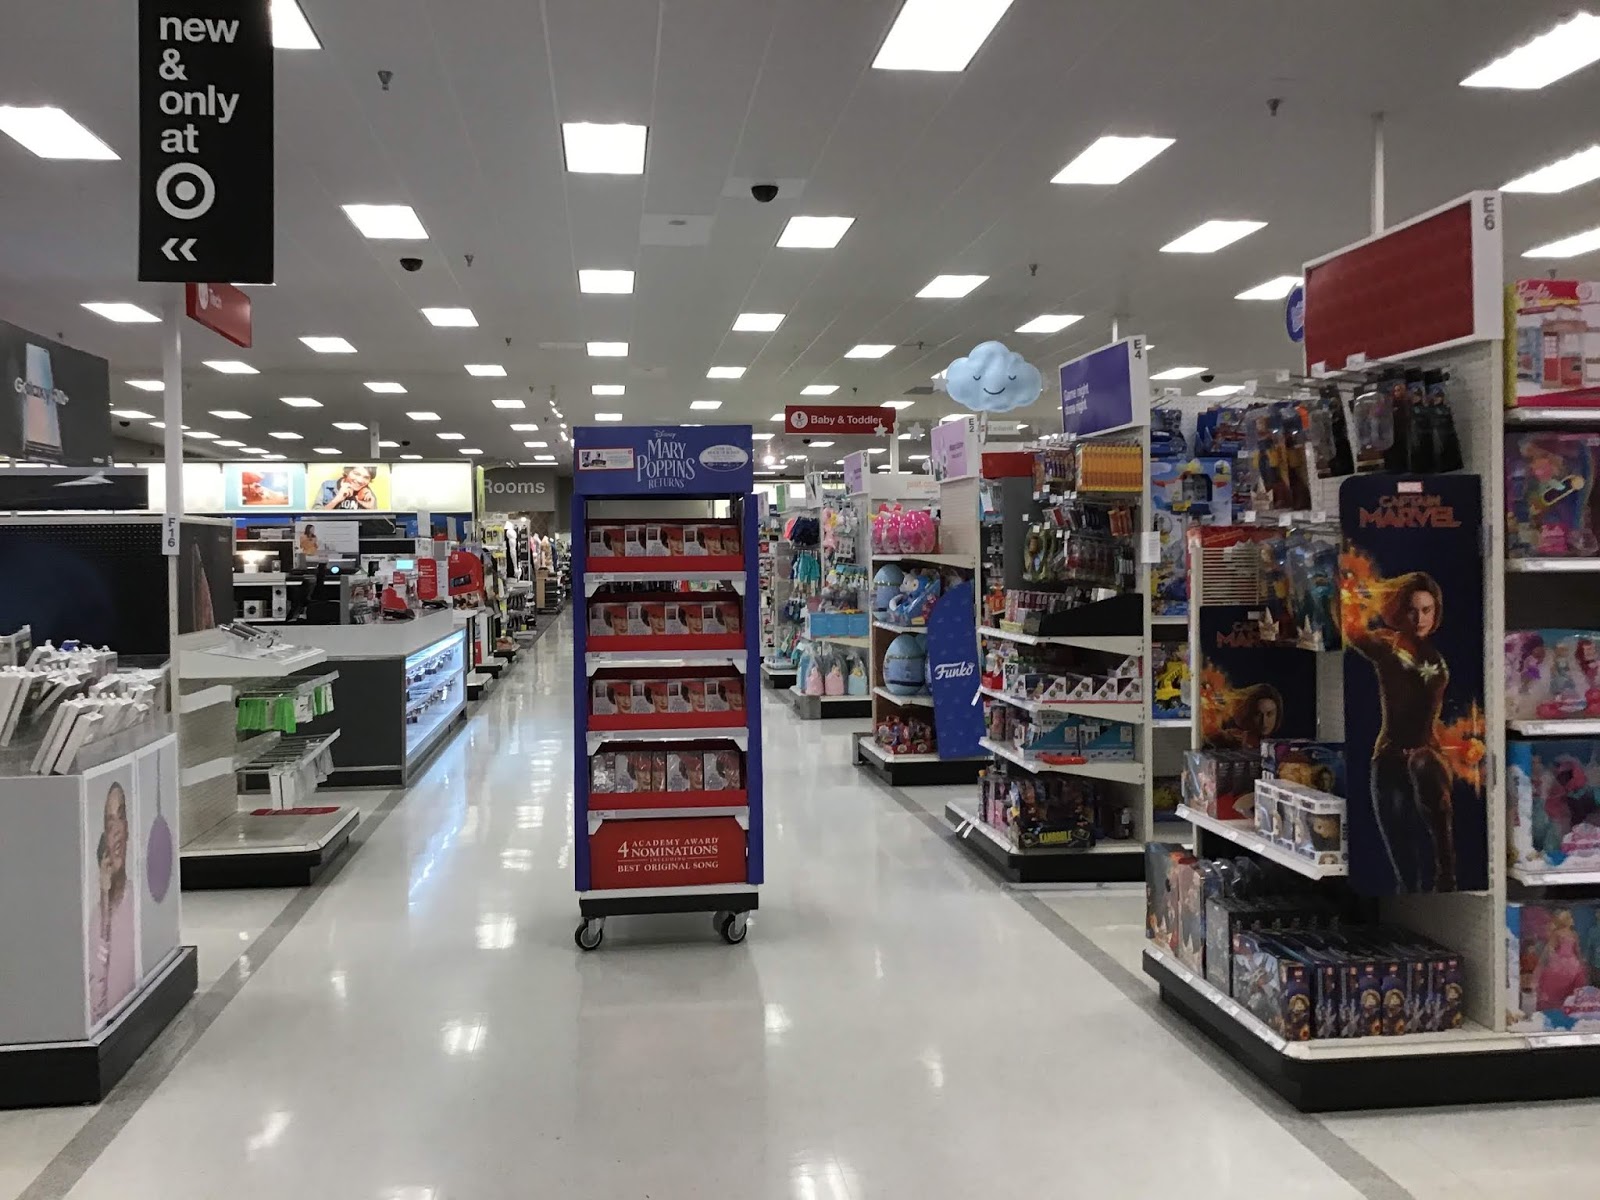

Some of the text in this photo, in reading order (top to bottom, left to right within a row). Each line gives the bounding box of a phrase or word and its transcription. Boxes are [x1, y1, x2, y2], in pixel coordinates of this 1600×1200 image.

[159, 16, 240, 43] new
[159, 48, 188, 81] &
[159, 84, 240, 124] only
[160, 123, 200, 154] at
[810, 415, 882, 426] Baby & Toddler
[653, 429, 676, 440] Disney
[647, 438, 687, 460] MARY
[636, 454, 696, 483] POPPINS
[648, 477, 685, 489] RETURNS
[1359, 506, 1462, 528] MARVEL
[934, 661, 975, 680] Funko
[617, 841, 629, 859] 4
[631, 845, 718, 857] NOMINATIONS
[632, 839, 680, 847] ACADEMY
[617, 860, 719, 873] BEST ORIGINAL SONG
